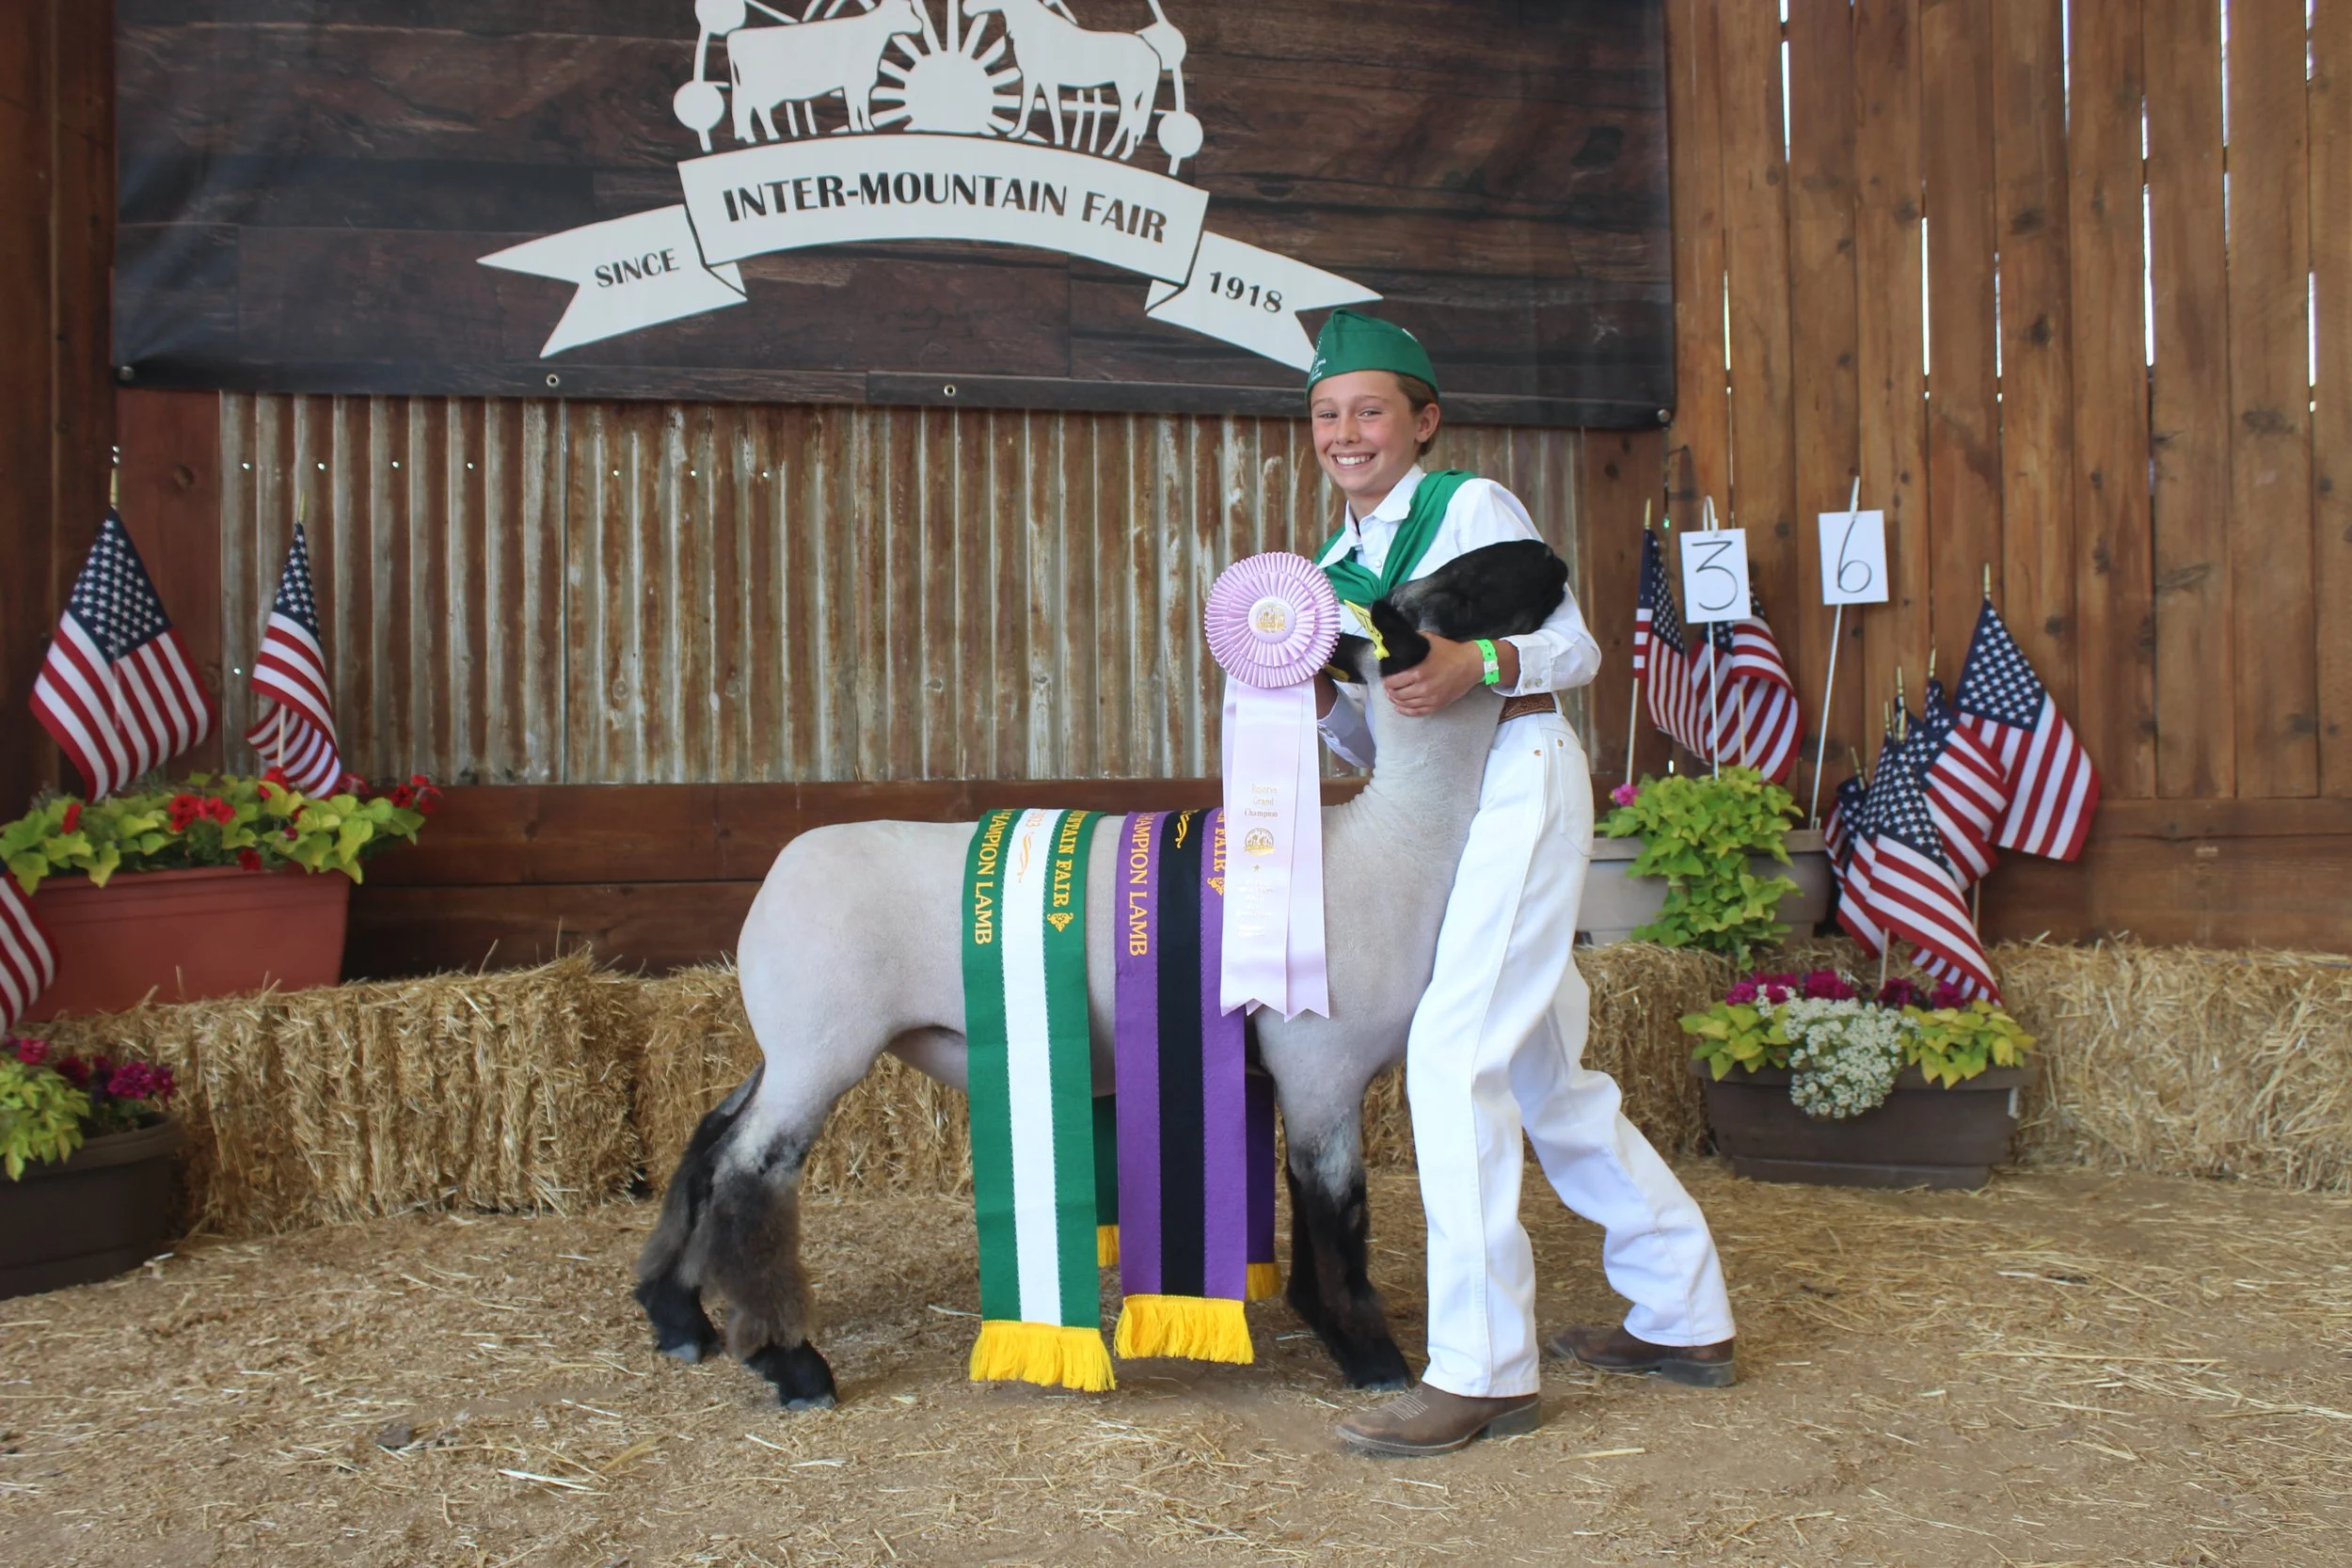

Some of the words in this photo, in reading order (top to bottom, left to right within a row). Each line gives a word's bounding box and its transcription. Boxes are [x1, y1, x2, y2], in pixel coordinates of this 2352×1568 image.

[723, 171, 1067, 222] INTER-MOUNTAIN
[1082, 191, 1168, 244] FAIR
[595, 247, 680, 288] SINCE
[1210, 271, 1282, 313] 1918
[1692, 541, 1739, 610] 3
[1837, 520, 1872, 593] 6
[1244, 808, 1279, 819] Champion
[1252, 796, 1275, 806] Grand
[977, 809, 1012, 876] HAMPION
[975, 881, 993, 944] LAMB
[1053, 860, 1073, 908] FAIR
[1129, 892, 1148, 957] LAMB
